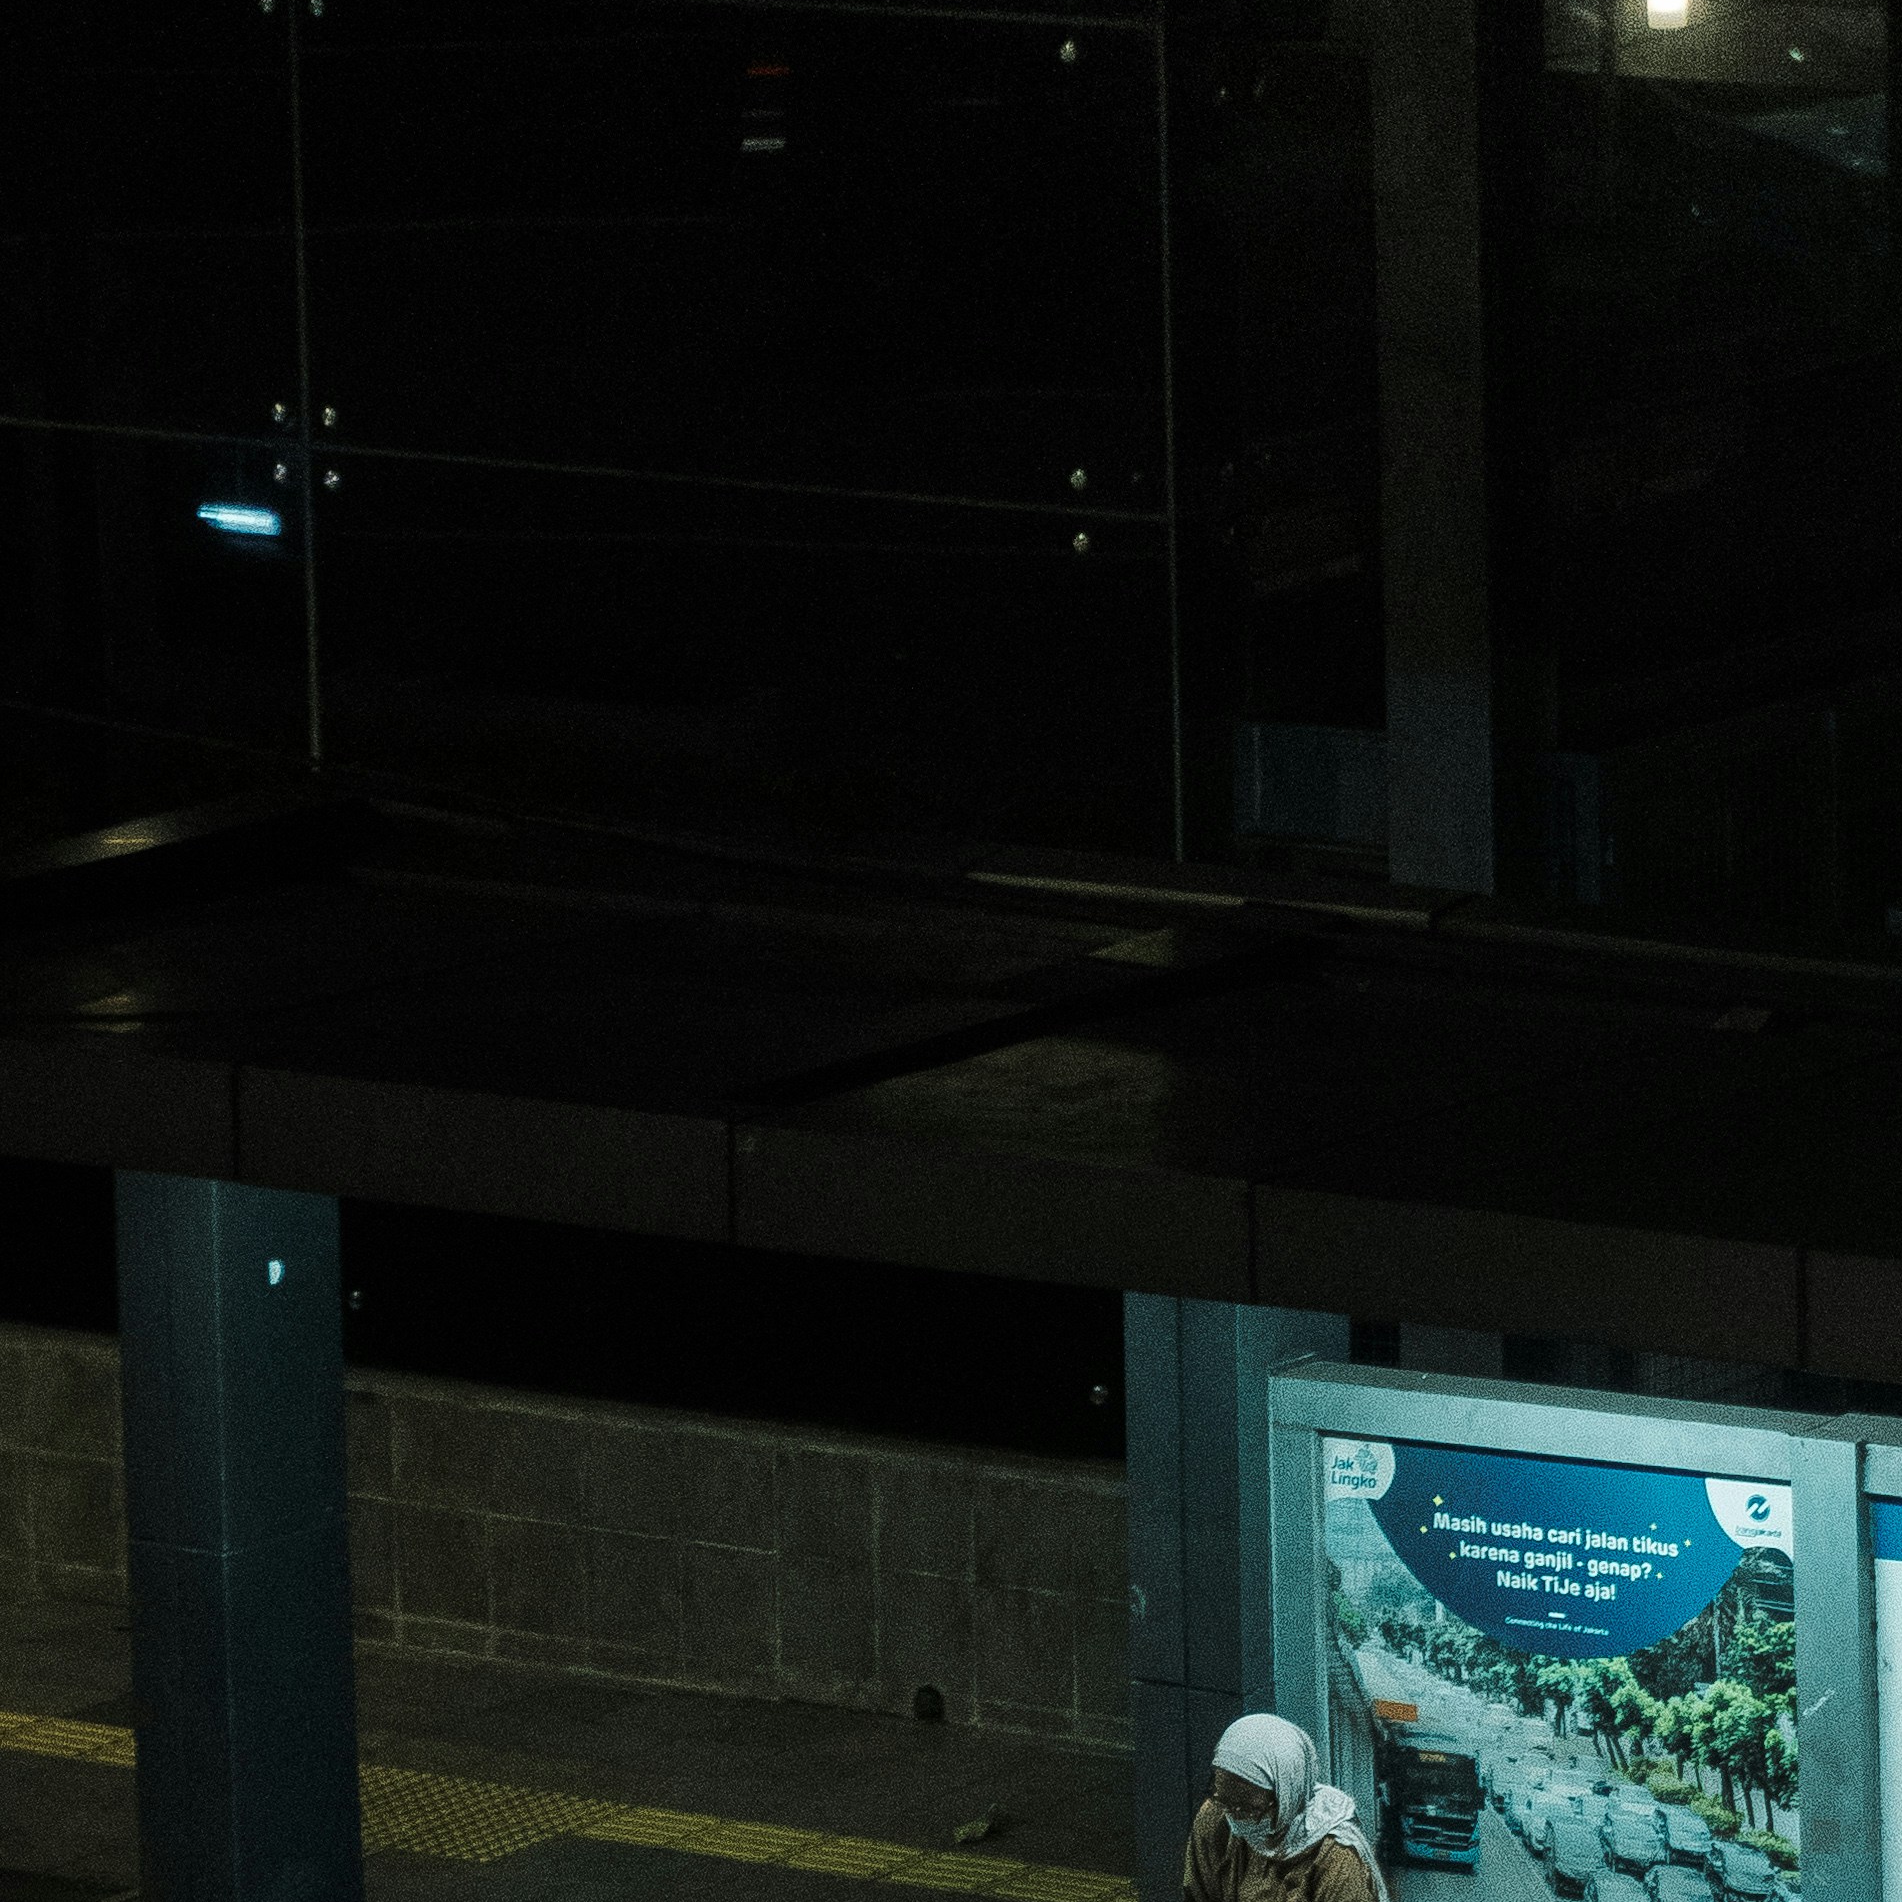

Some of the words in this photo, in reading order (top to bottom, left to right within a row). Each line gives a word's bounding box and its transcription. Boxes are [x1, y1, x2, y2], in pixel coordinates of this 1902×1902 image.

[1331, 1455, 1354, 1471] Jak
[1331, 1470, 1378, 1489] Lingko
[1432, 1511, 1487, 1534] Masih
[1490, 1521, 1543, 1542] usaha
[1547, 1527, 1582, 1546] cari
[1584, 1528, 1629, 1551] jalan
[1632, 1535, 1679, 1558] tikus
[1459, 1540, 1520, 1564] karena
[1523, 1551, 1573, 1572] ganjil
[1587, 1558, 1652, 1581] genap?
[1496, 1570, 1539, 1592] Naik
[1541, 1574, 1581, 1597] TiJe
[1584, 1581, 1616, 1603] aja!
